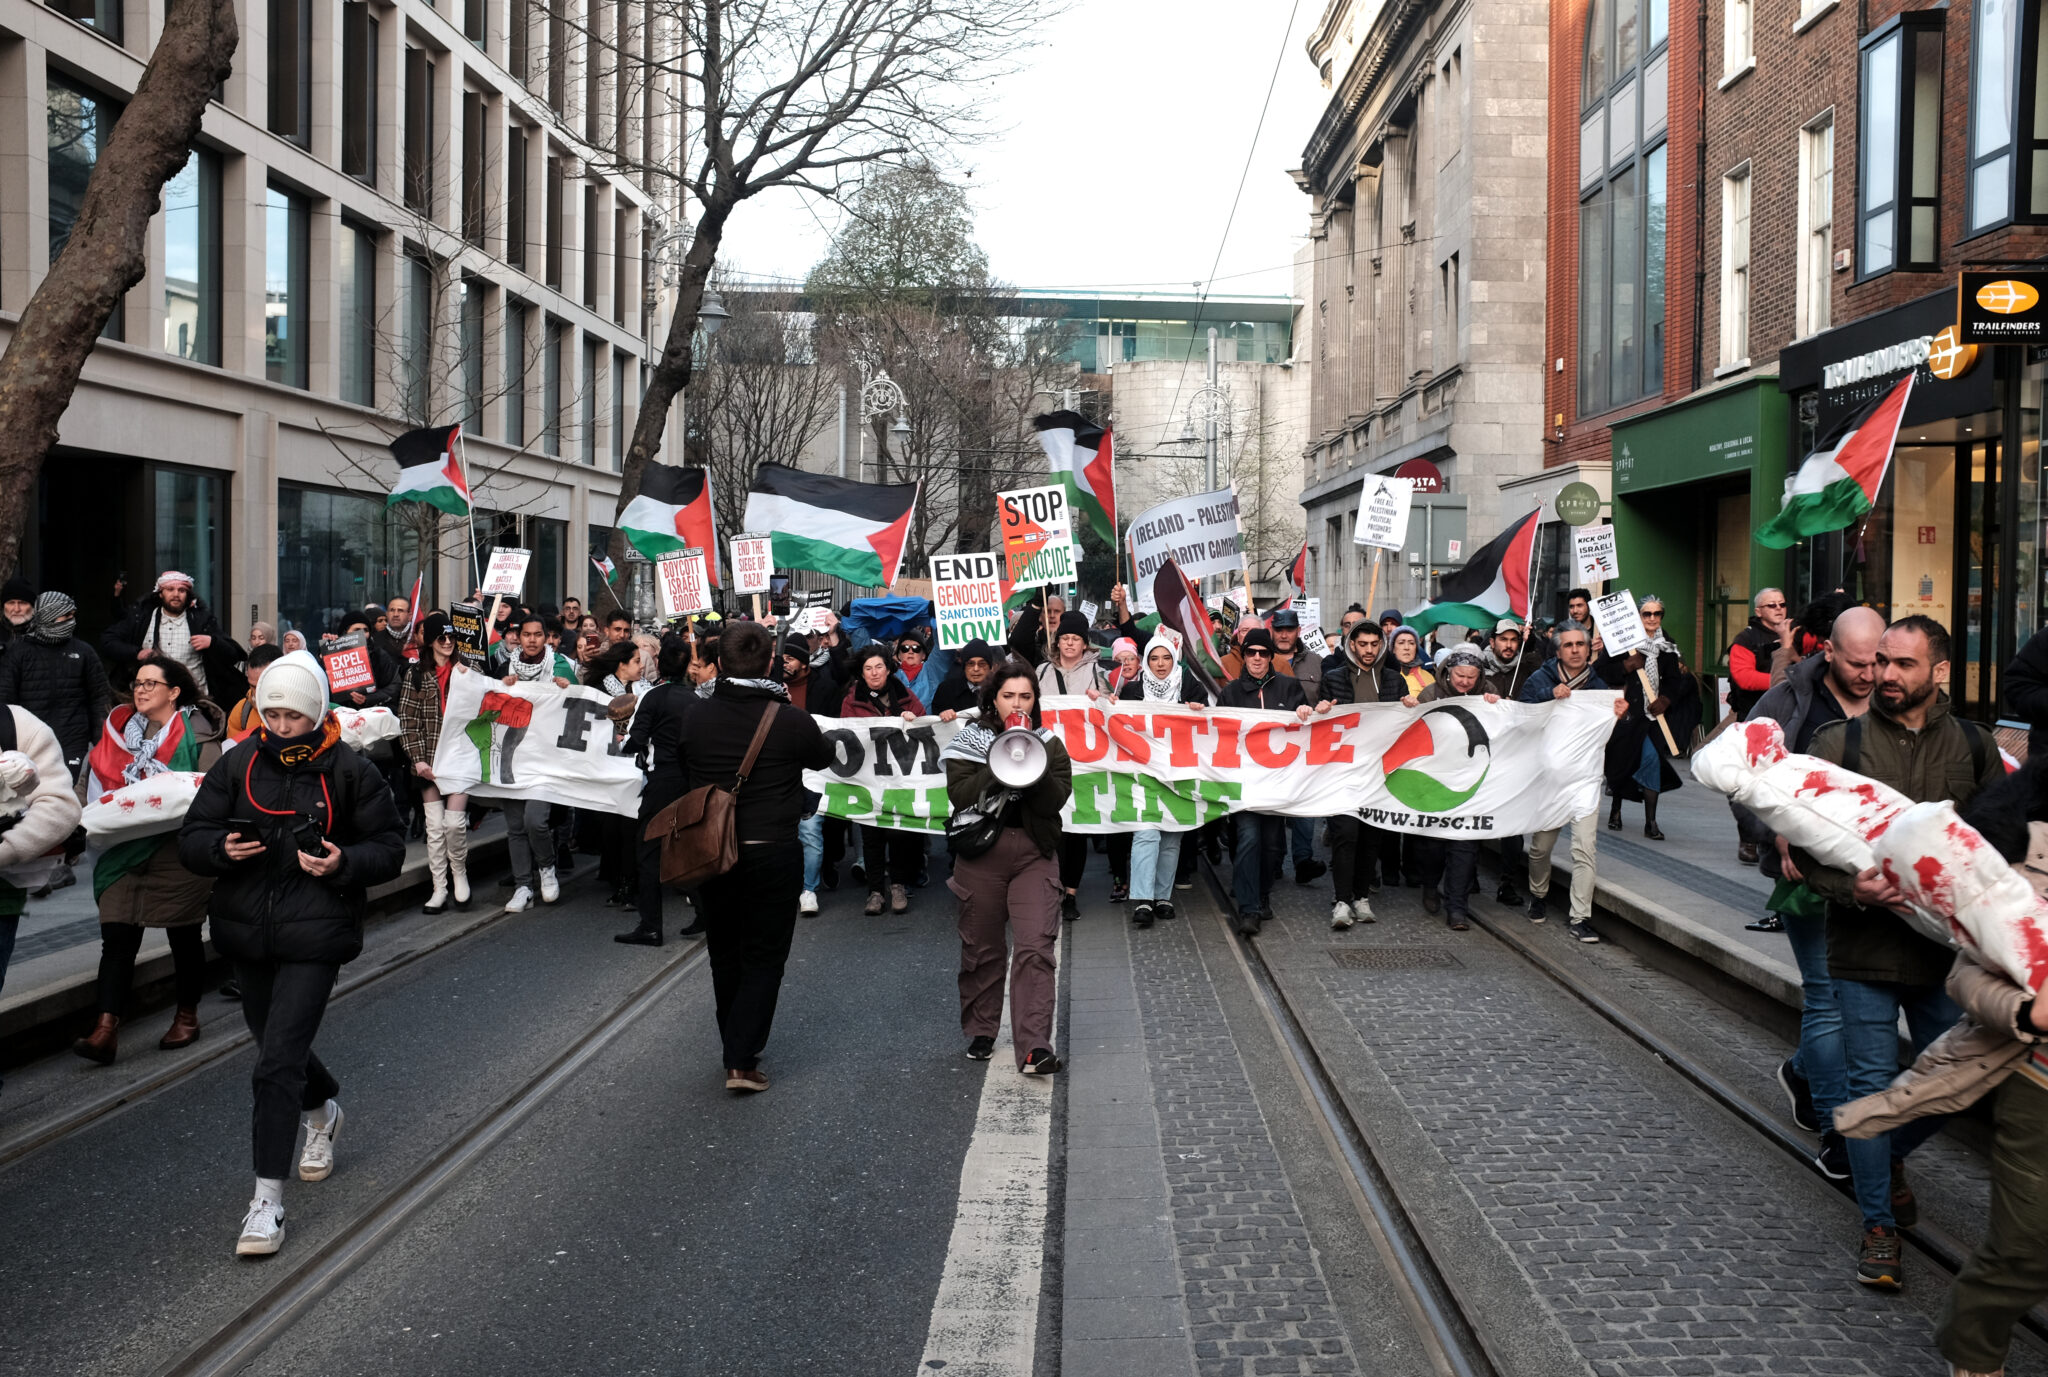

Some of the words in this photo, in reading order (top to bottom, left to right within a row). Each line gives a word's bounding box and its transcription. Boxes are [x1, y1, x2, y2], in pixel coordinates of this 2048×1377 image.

[1972, 322, 2040, 330] TRAILFINDERS
[1829, 394, 1845, 408] THE
[1004, 490, 1062, 527] STOP
[1135, 513, 1185, 546] IRELAND
[1578, 536, 1596, 544] KICK
[1597, 533, 1612, 541] OUT
[737, 541, 750, 556] END
[751, 540, 764, 555] THE
[1579, 542, 1613, 554] ISRAELI
[663, 557, 700, 579] BOYCOTT
[738, 557, 756, 572] SIEGE
[757, 556, 766, 570] OF
[934, 557, 994, 582] END
[1011, 546, 1073, 584] GENOCIDE
[668, 574, 701, 596] ISRAELI
[743, 572, 763, 588] GAZA!
[673, 591, 701, 612] GOODS
[810, 591, 823, 599] must
[938, 582, 998, 607] GENOCIDE
[1599, 592, 1624, 608] GAZA
[808, 598, 831, 608] genocide
[940, 605, 1000, 620] SANCTIONS
[1602, 610, 1616, 619] STOP
[466, 617, 477, 625] THE
[459, 627, 476, 636] GAZA
[941, 619, 1001, 645] NOW
[1303, 629, 1318, 641] OUT
[1611, 629, 1624, 638] END
[330, 651, 364, 670] EXPEL
[332, 669, 345, 680] THE
[344, 664, 367, 677] ISRAELI
[332, 672, 372, 689] AMBASSADOR
[1358, 807, 1494, 831] WWW.IPSC.IE
